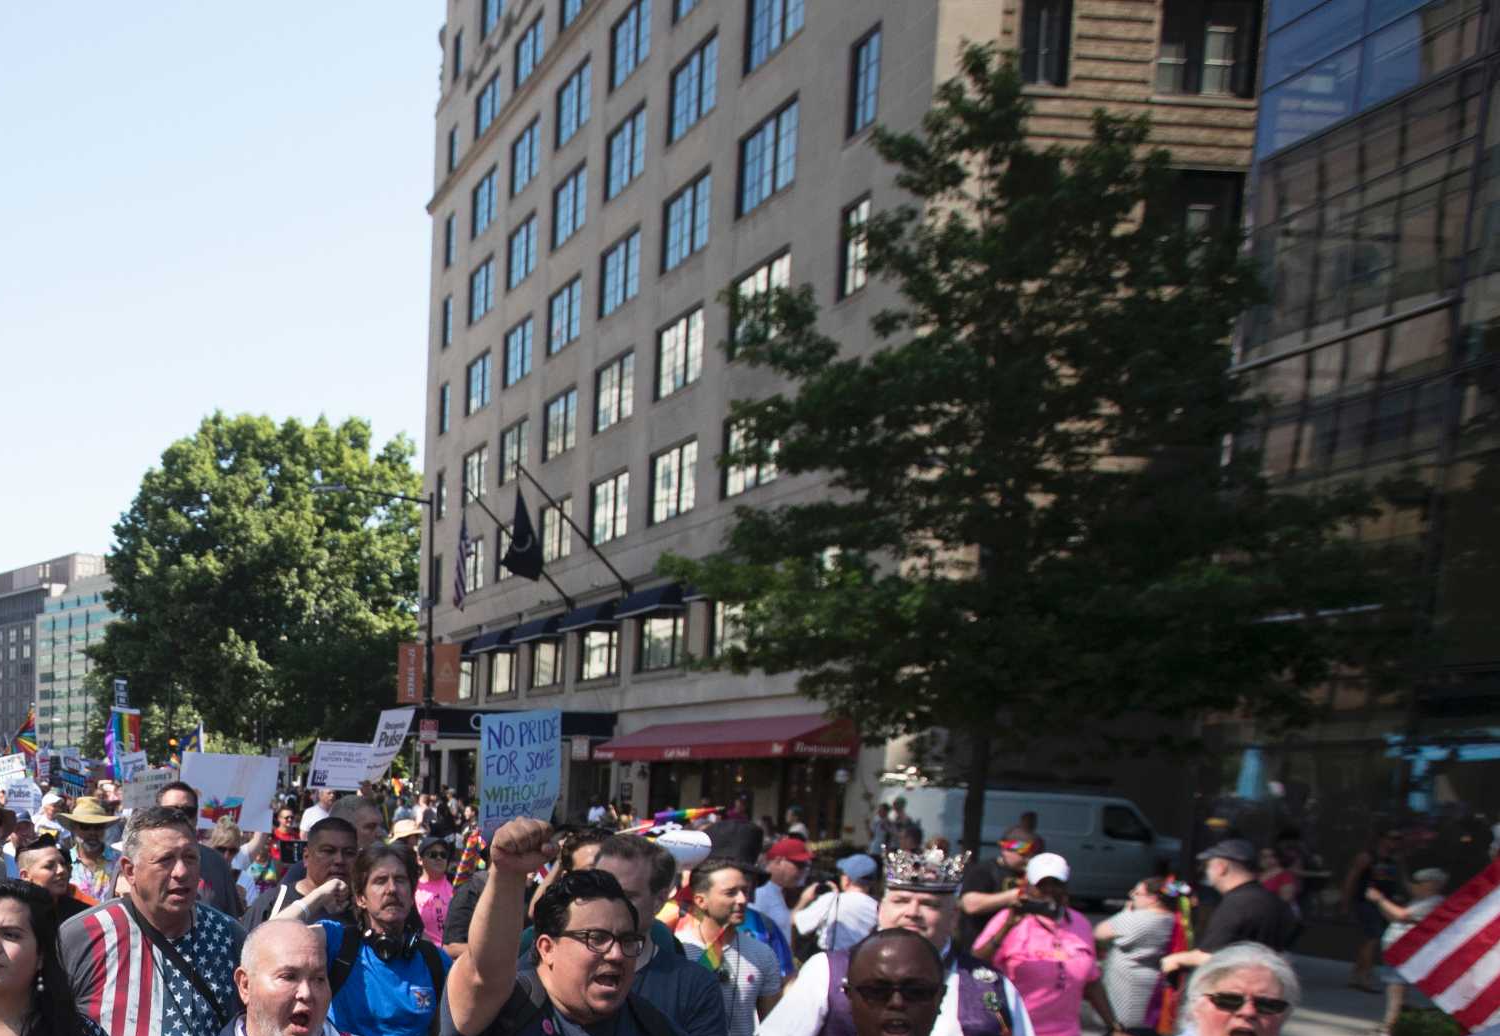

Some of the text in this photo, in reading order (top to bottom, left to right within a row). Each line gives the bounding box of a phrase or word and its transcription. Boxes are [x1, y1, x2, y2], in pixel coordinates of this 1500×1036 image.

[378, 731, 404, 748] Pulse
[487, 720, 515, 750] NO
[519, 716, 558, 747] PRIDE
[485, 750, 520, 776] FOR
[484, 781, 548, 803] WITHOUT
